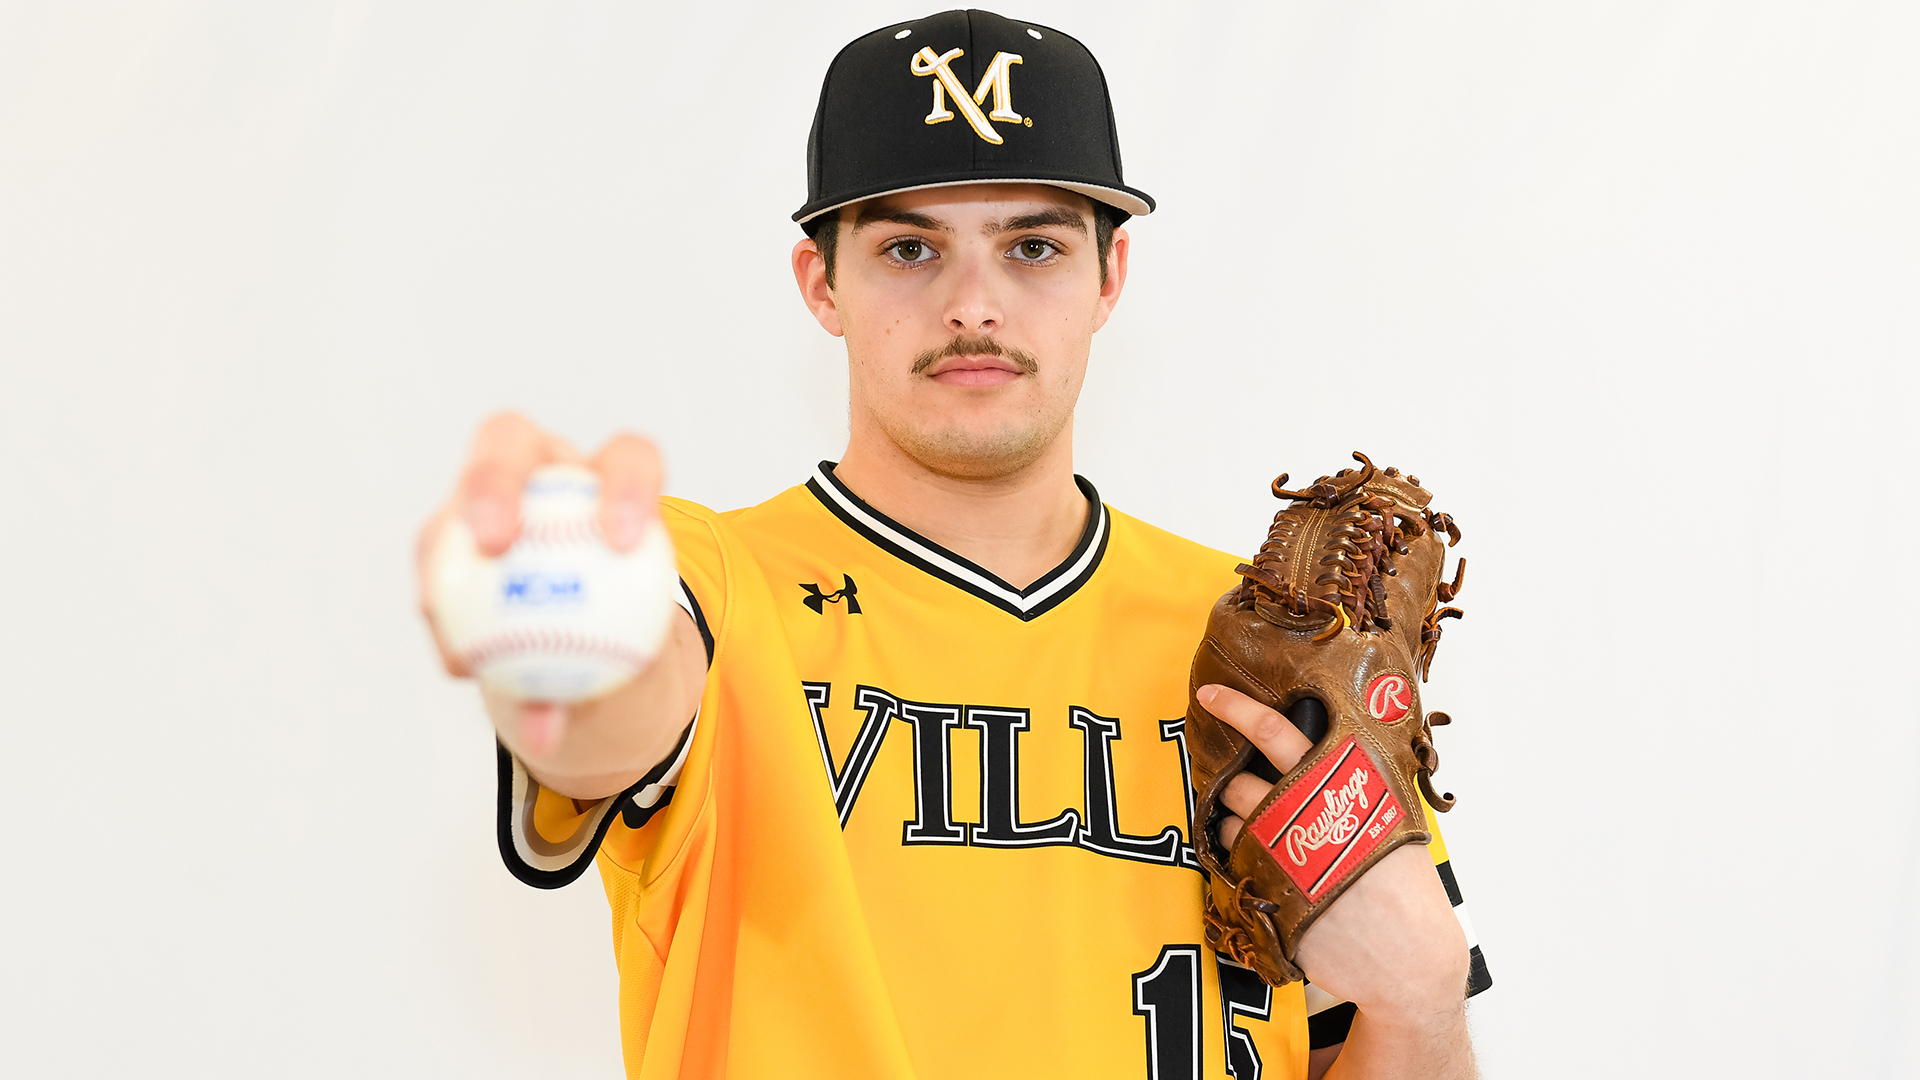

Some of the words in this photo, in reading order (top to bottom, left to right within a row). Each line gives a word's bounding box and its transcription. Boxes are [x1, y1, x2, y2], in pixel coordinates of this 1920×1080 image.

[910, 46, 1024, 145] M
[1369, 676, 1409, 719] R
[1286, 767, 1369, 867] Rawlings
[1367, 822, 1386, 839] Est.
[1381, 805, 1398, 826] 1887
[1131, 944, 1274, 1080] 15
